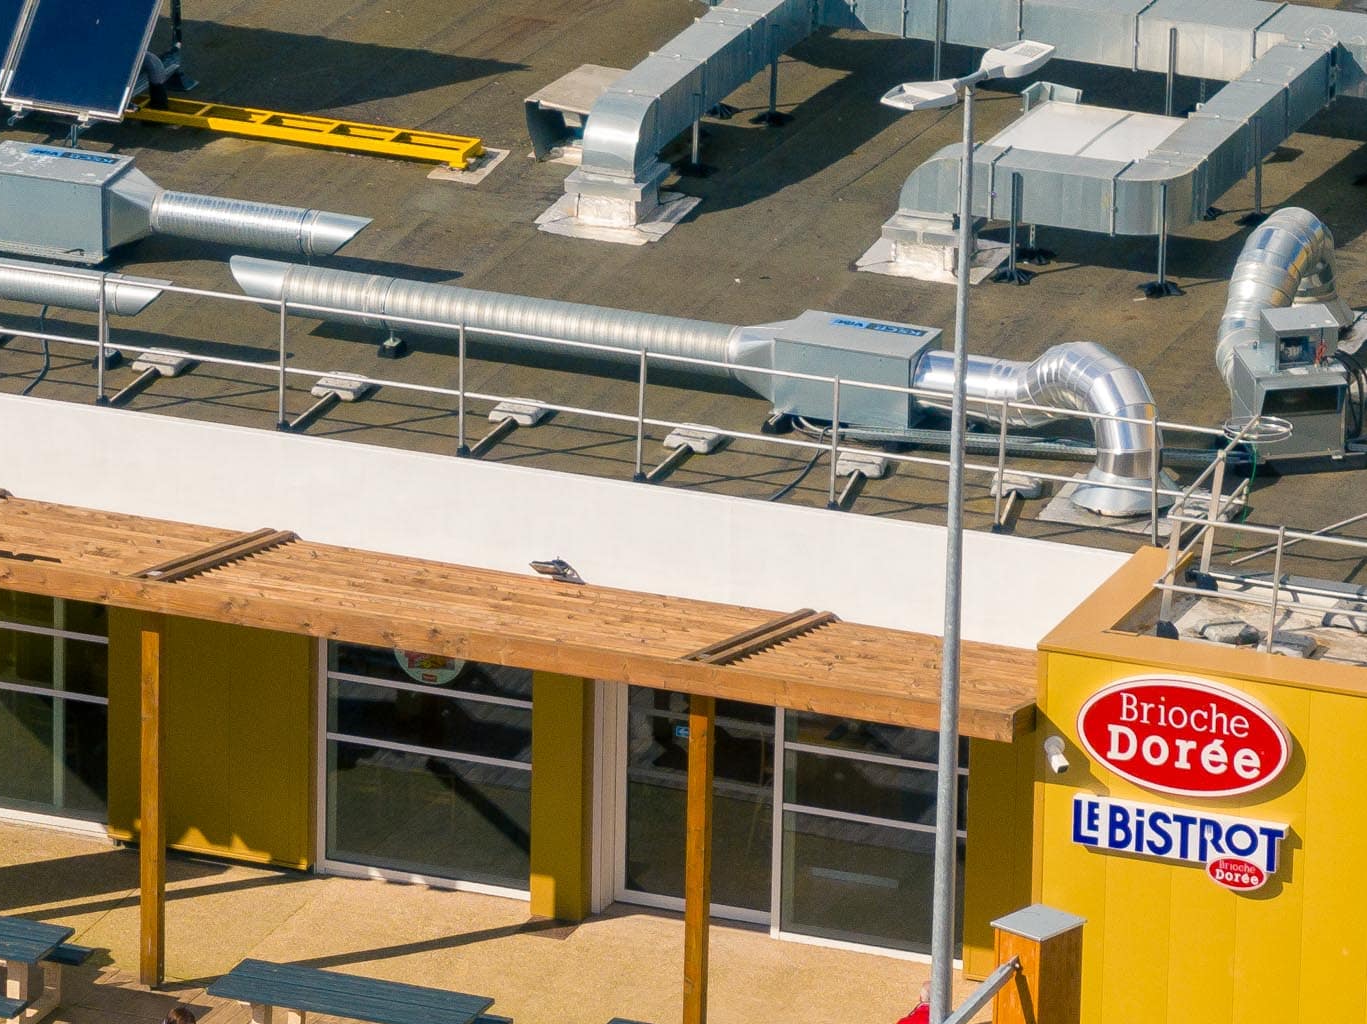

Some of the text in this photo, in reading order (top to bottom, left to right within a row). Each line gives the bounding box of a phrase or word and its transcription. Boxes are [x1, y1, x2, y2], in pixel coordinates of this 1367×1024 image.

[1119, 692, 1250, 738] Brioche
[1106, 723, 1262, 779] Dorée
[1073, 799, 1099, 846] LE
[1215, 868, 1259, 885] Dorée
[1219, 859, 1256, 873] Brioche
